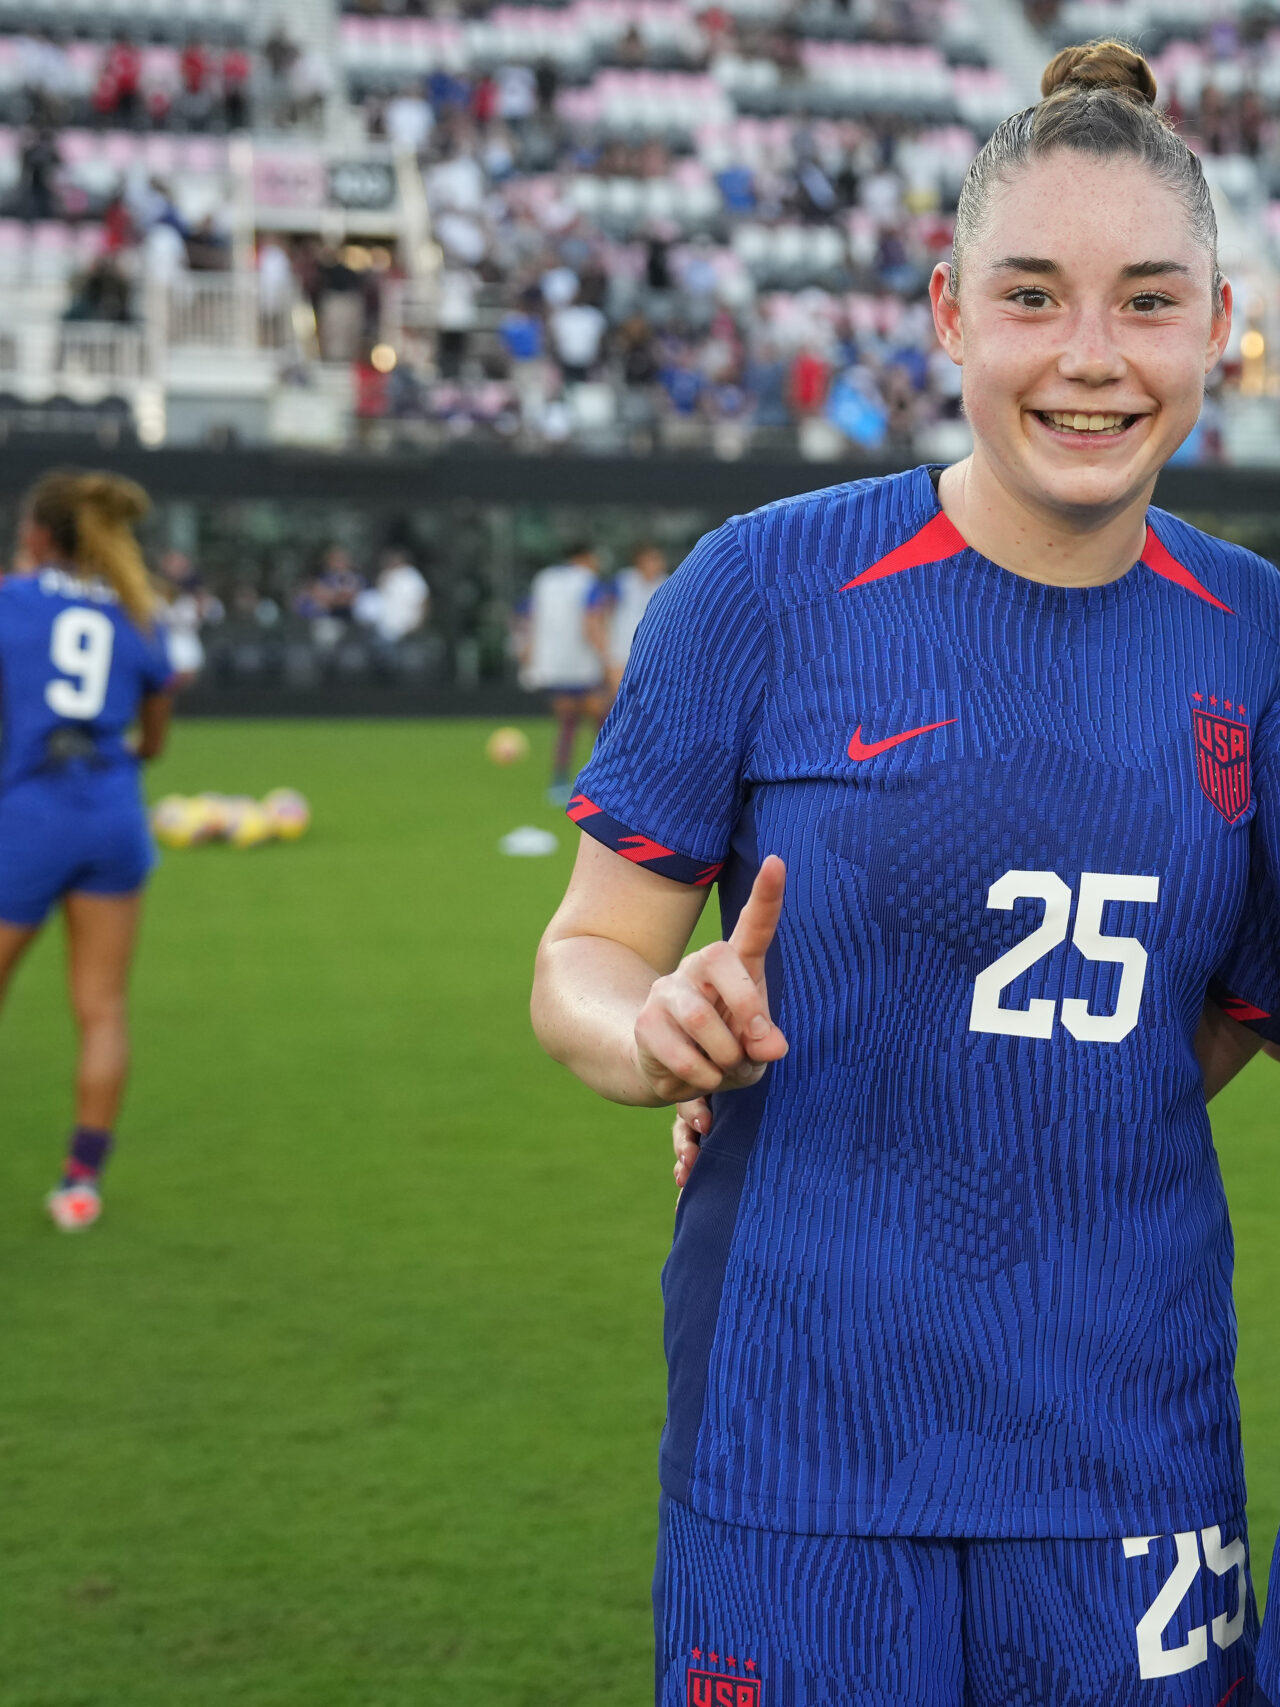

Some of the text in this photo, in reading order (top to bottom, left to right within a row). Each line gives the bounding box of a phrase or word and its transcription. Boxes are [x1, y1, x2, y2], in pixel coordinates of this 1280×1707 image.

[44, 606, 115, 720] 9
[1197, 717, 1244, 764] USA
[969, 869, 1160, 1043] 25
[1122, 1524, 1247, 1680] 25
[693, 1677, 754, 1707] USA
